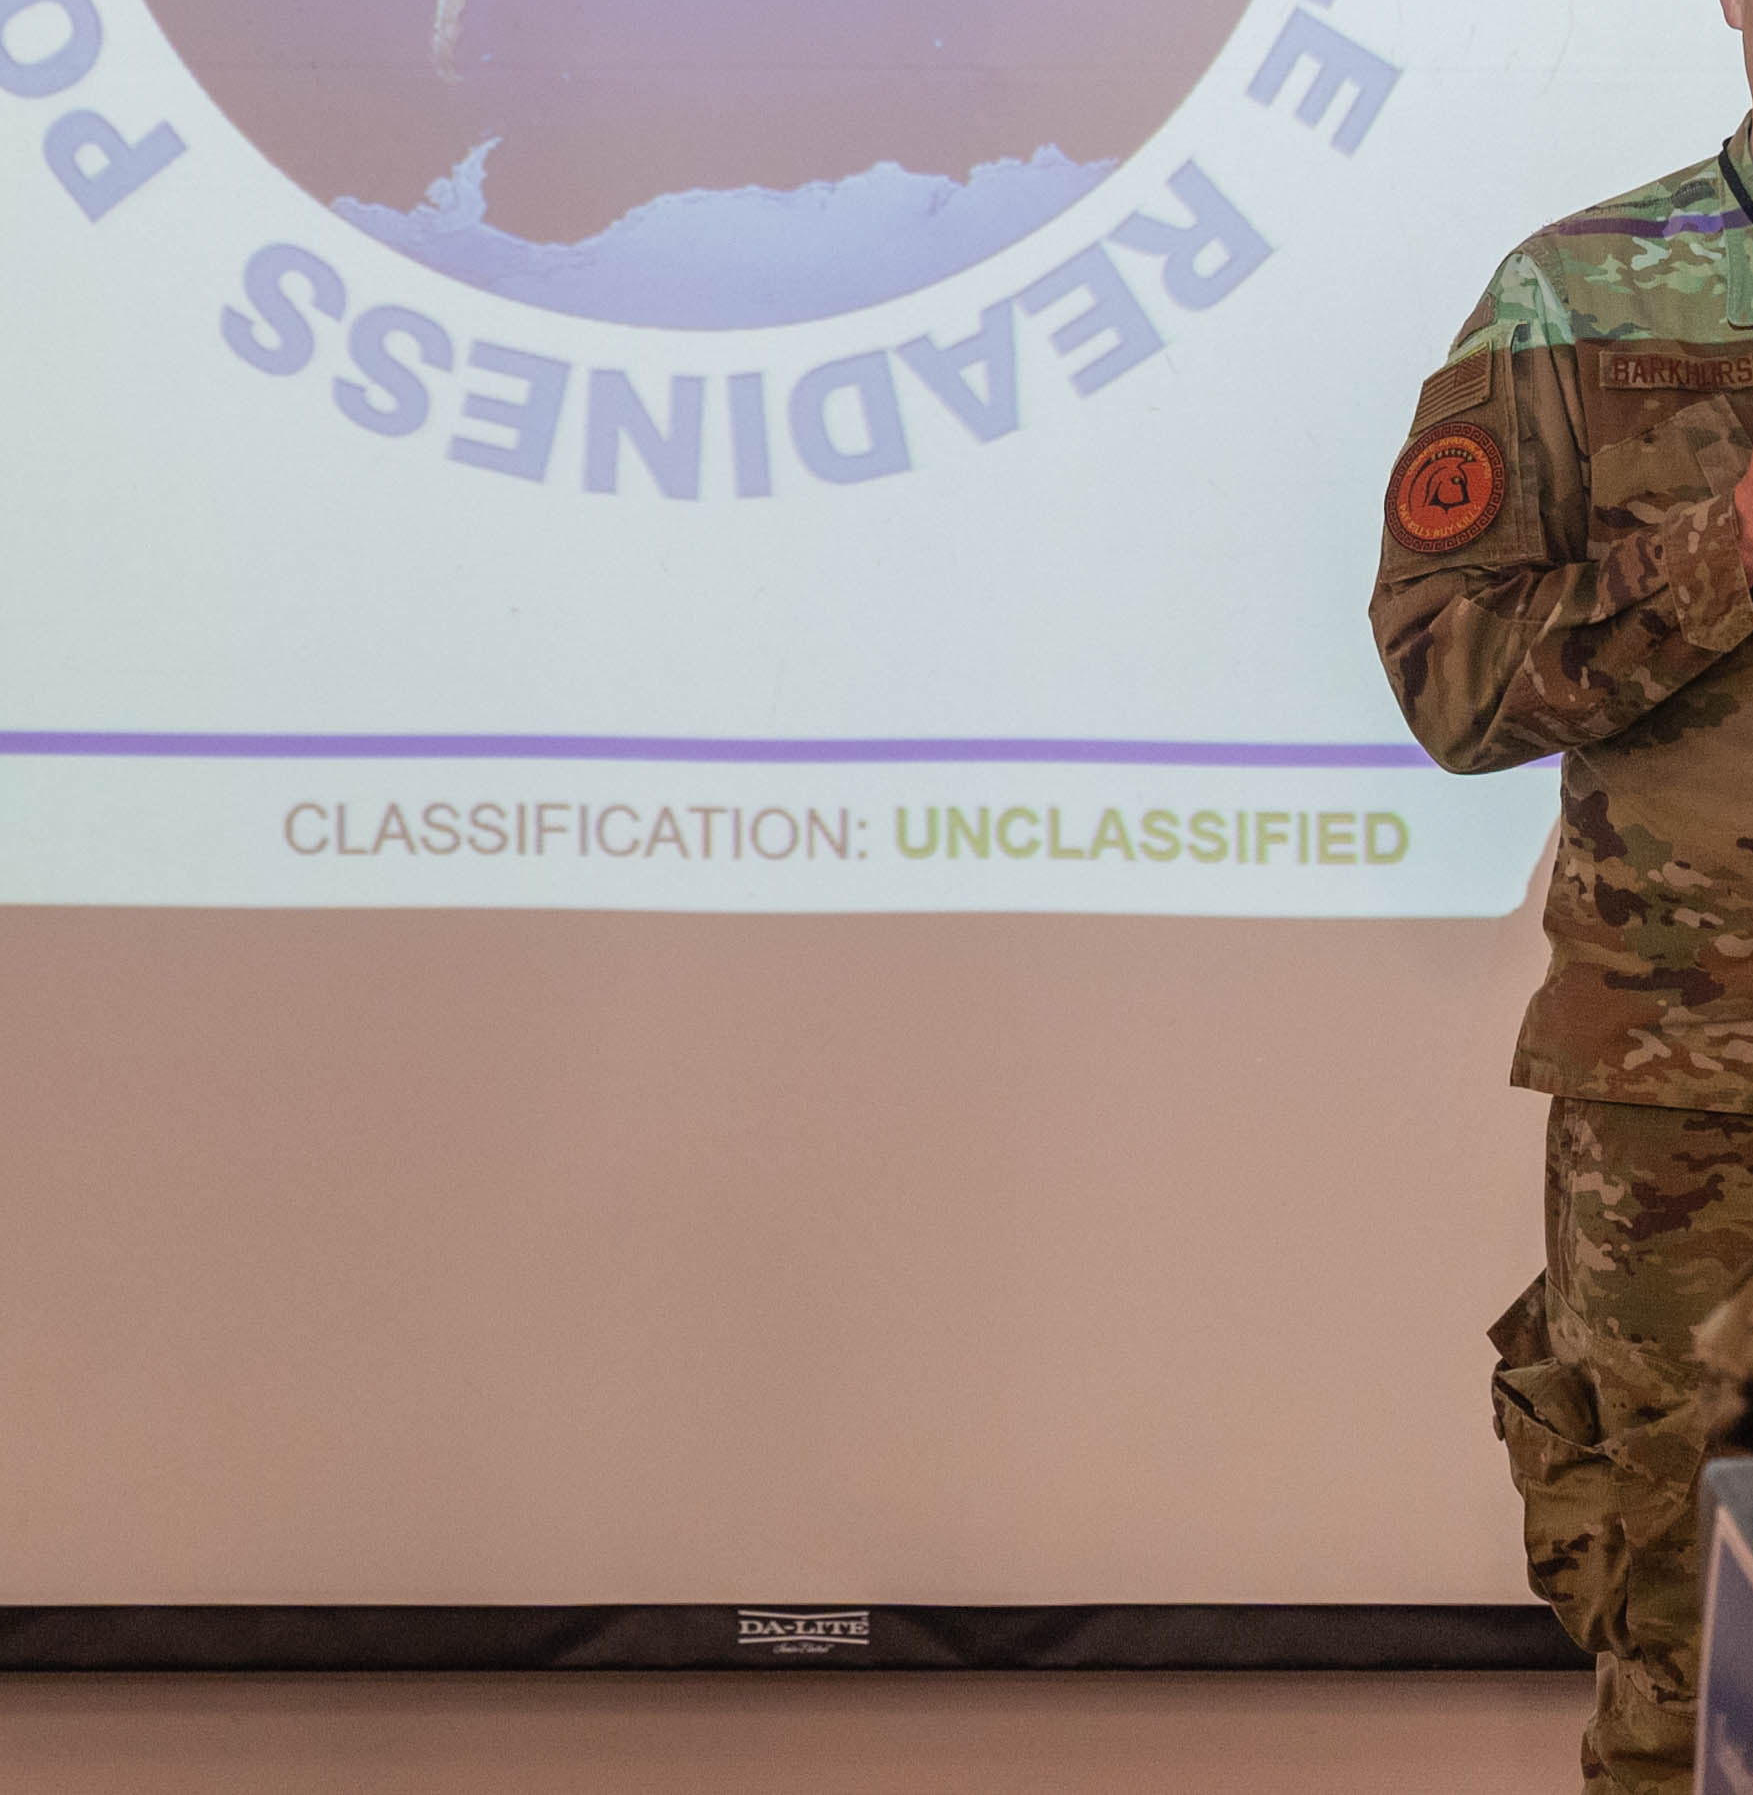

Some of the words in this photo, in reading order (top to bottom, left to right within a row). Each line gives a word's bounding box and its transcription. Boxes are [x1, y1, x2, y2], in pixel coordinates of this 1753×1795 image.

[219, 158, 1274, 501] READINESS
[282, 801, 870, 862] CLASSIFICATION:
[894, 805, 1412, 867] UNCLASSIFIED
[739, 1620, 870, 1635] DA-LITE
